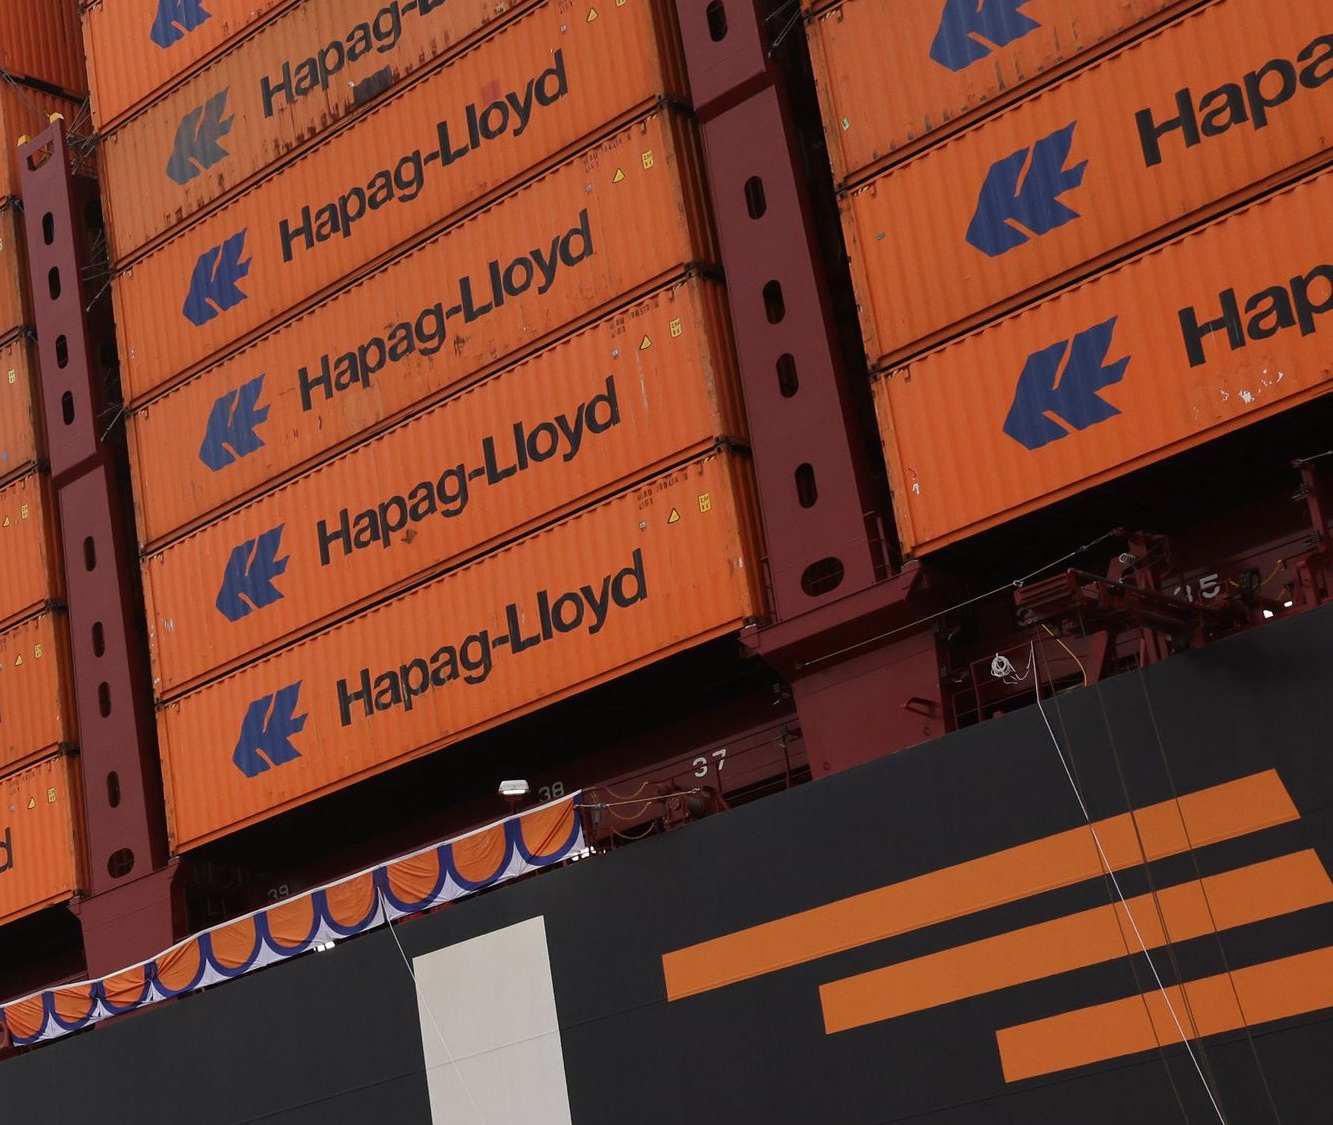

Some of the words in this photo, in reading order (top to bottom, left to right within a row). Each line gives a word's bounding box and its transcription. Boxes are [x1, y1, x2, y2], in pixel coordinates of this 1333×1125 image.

[280, 49, 567, 262] Hapag-Lloyd
[298, 209, 593, 411] Hapag-Lloyd
[318, 377, 619, 565] Hapag-Lloyd
[337, 550, 646, 726] Hapag-Lloyd
[693, 749, 726, 777] 37
